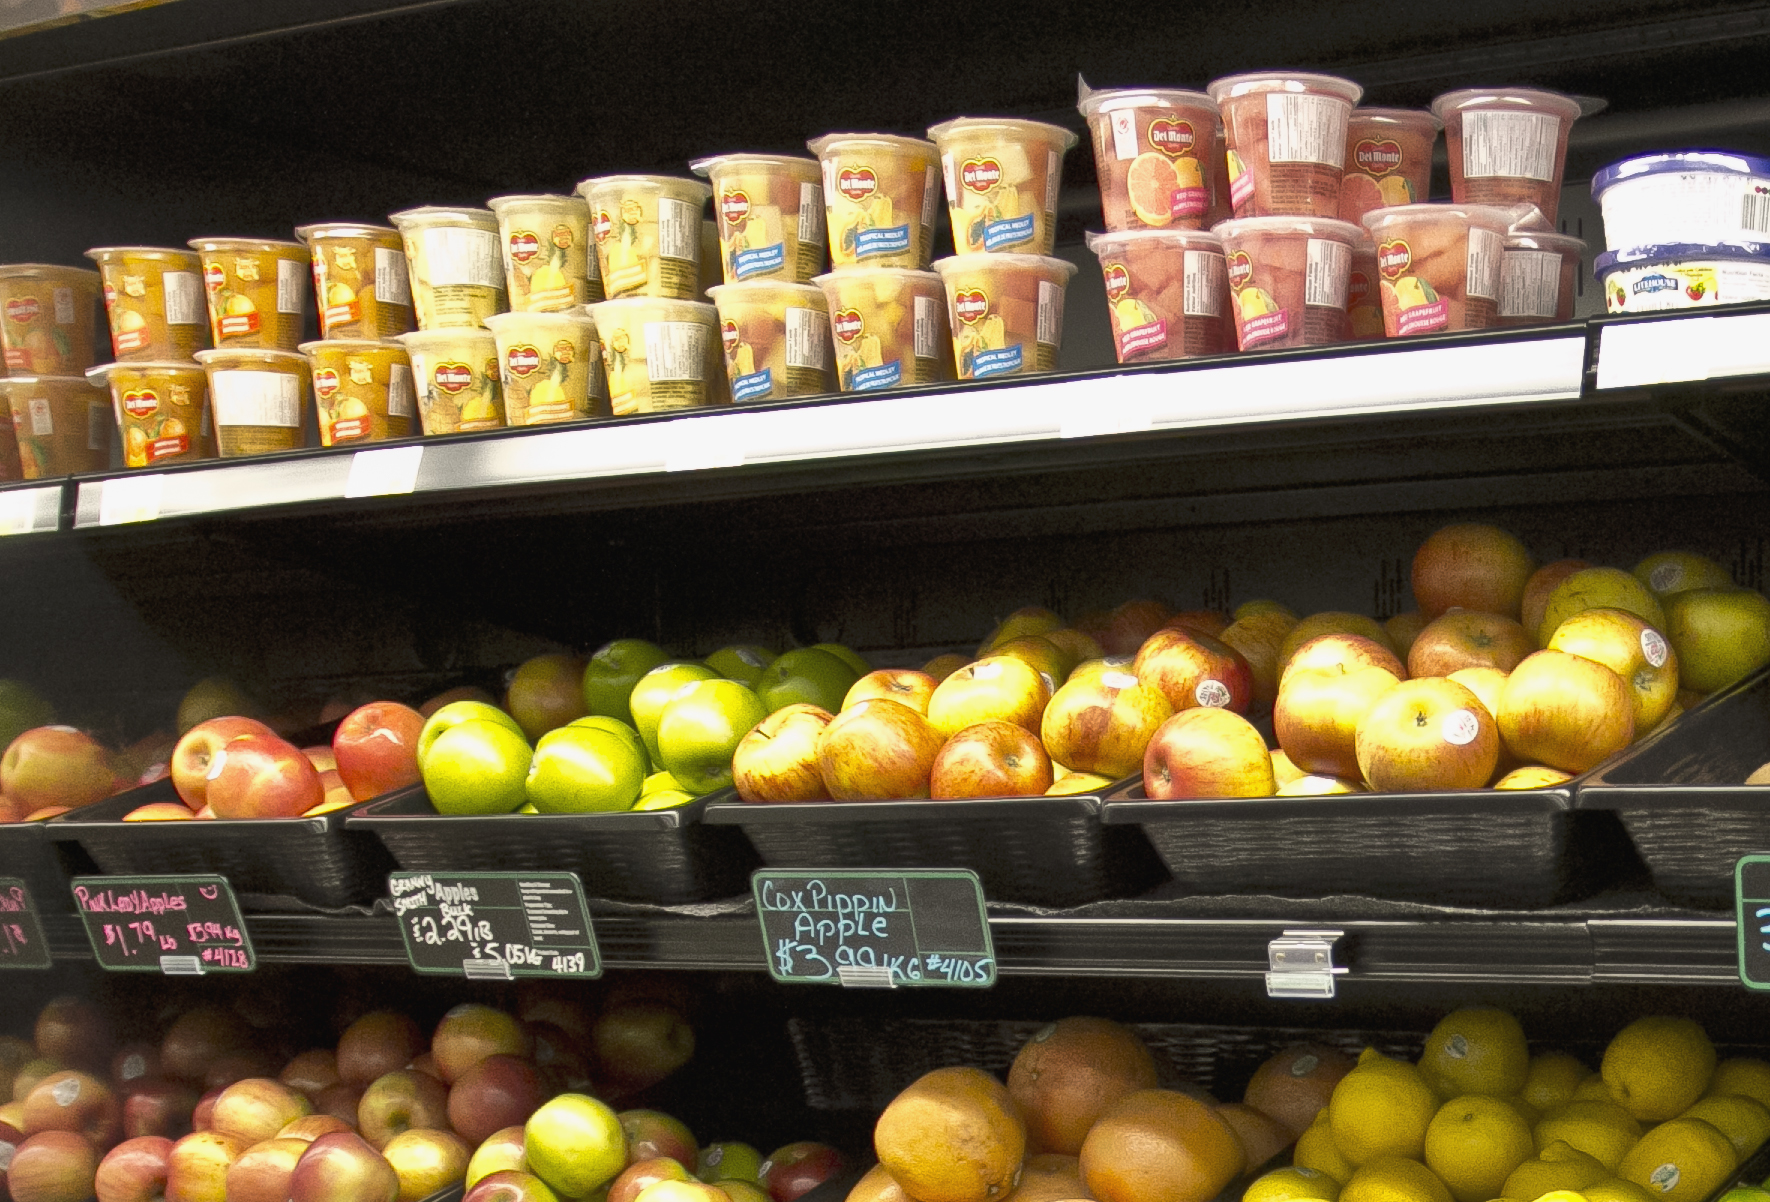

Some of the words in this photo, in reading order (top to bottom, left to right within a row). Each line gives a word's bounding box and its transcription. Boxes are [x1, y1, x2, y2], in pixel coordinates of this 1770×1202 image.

[1153, 130, 1167, 142] Del
[1168, 130, 1194, 144] Monte
[1359, 150, 1372, 162] Del
[1373, 151, 1399, 162] Monte
[854, 178, 876, 190] Monte
[1633, 275, 1679, 294] LITEHOUSE
[435, 883, 479, 904] Apples
[551, 952, 585, 973] 4139
[926, 954, 993, 982] #4105
